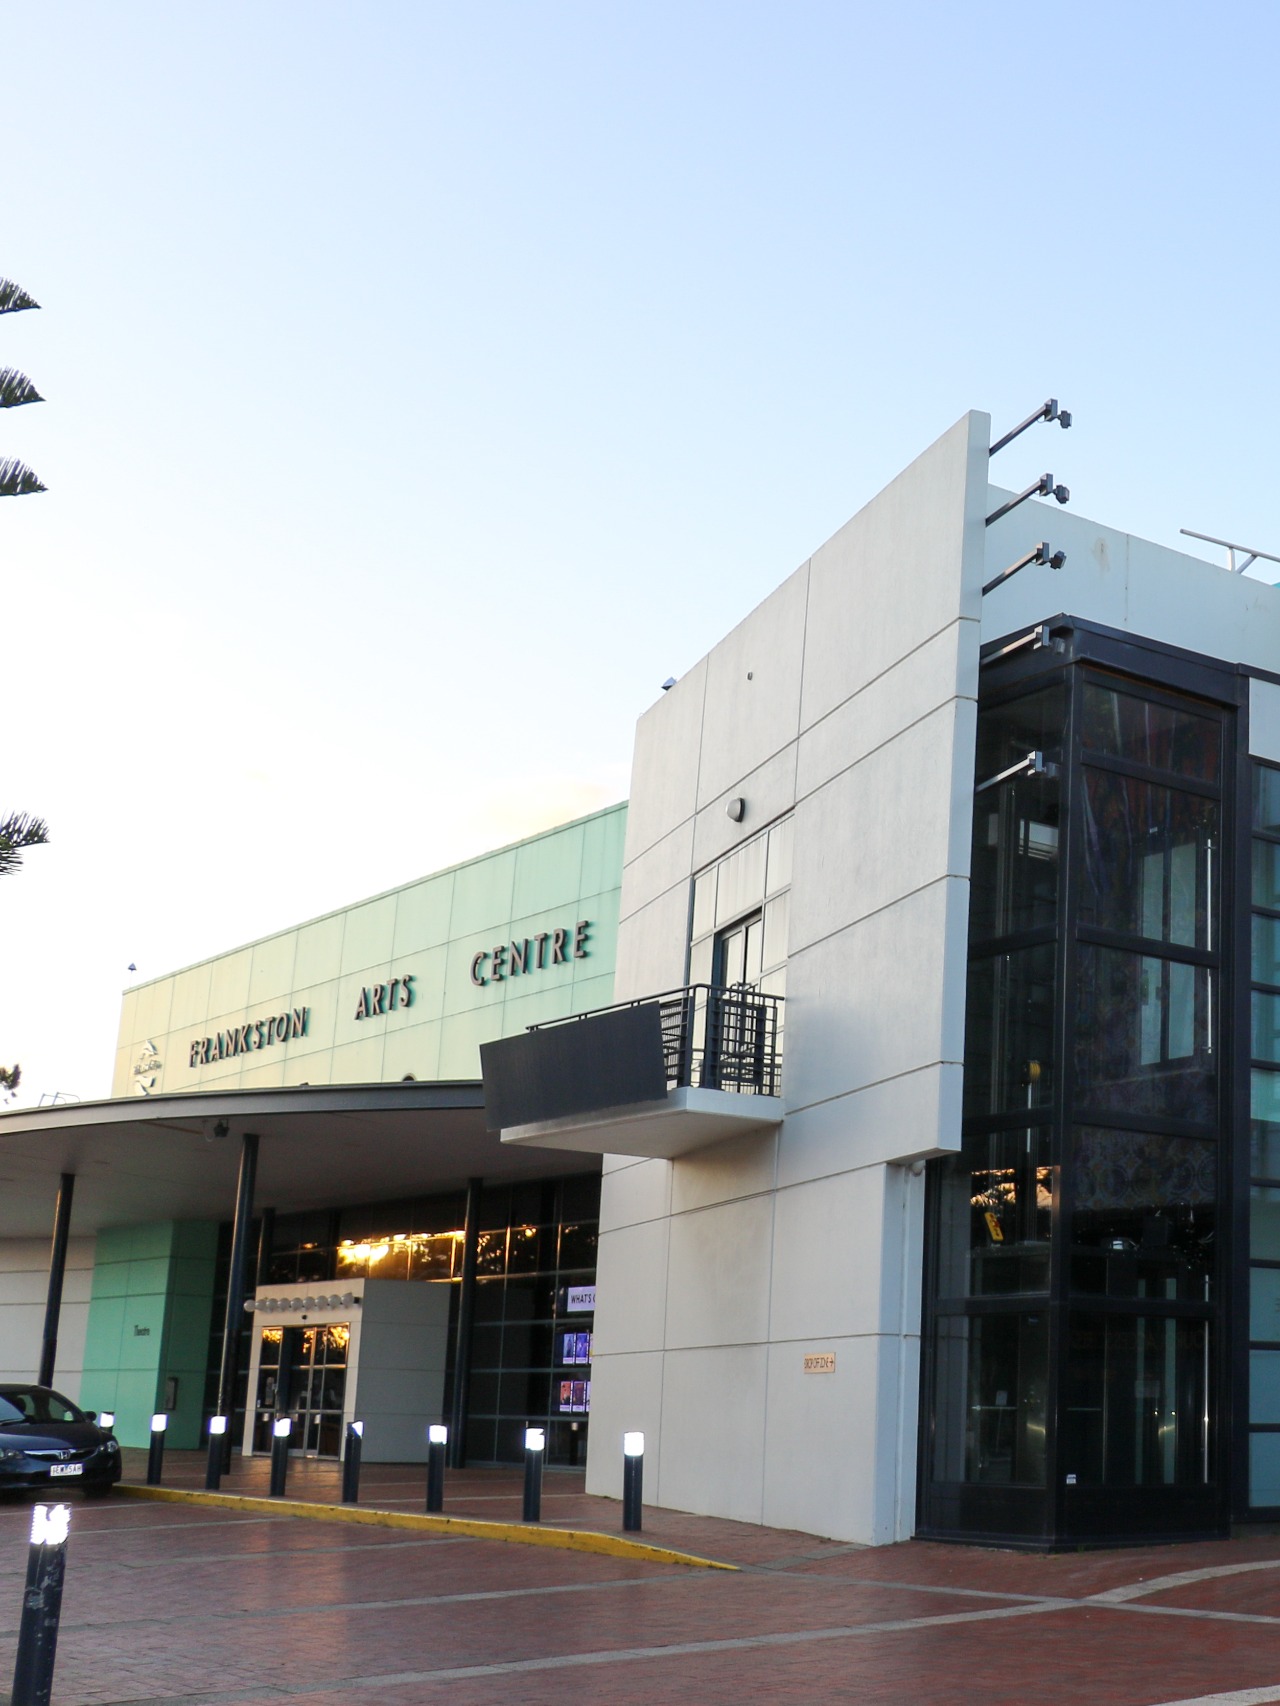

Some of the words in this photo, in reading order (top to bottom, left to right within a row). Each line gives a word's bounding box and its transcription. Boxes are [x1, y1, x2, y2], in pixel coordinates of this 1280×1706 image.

[189, 1006, 309, 1067] FRANKSTON
[354, 974, 416, 1020] ARTS
[470, 920, 591, 986] CENTRE
